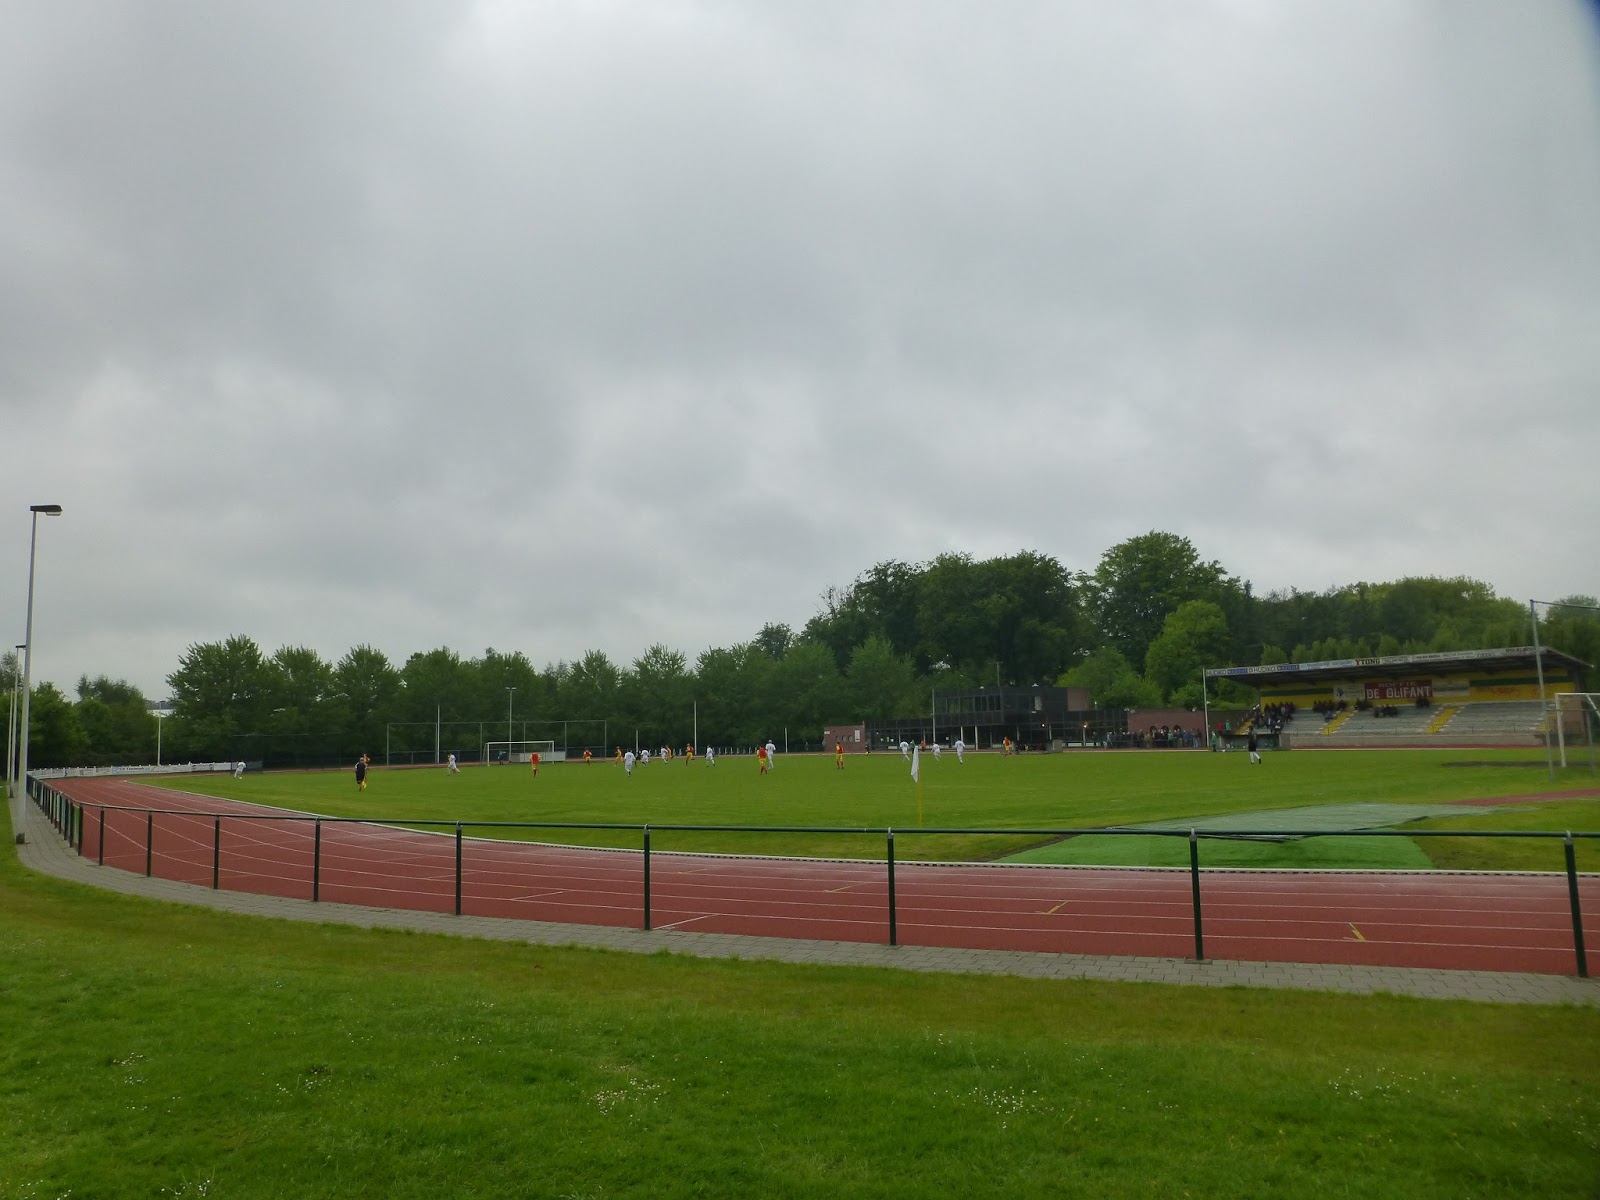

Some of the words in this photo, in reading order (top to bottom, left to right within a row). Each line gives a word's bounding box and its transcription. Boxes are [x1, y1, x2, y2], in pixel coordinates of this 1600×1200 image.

[1355, 658, 1381, 666] YTONG
[1366, 688, 1380, 699] DE
[1386, 685, 1430, 698] OLIFANT
